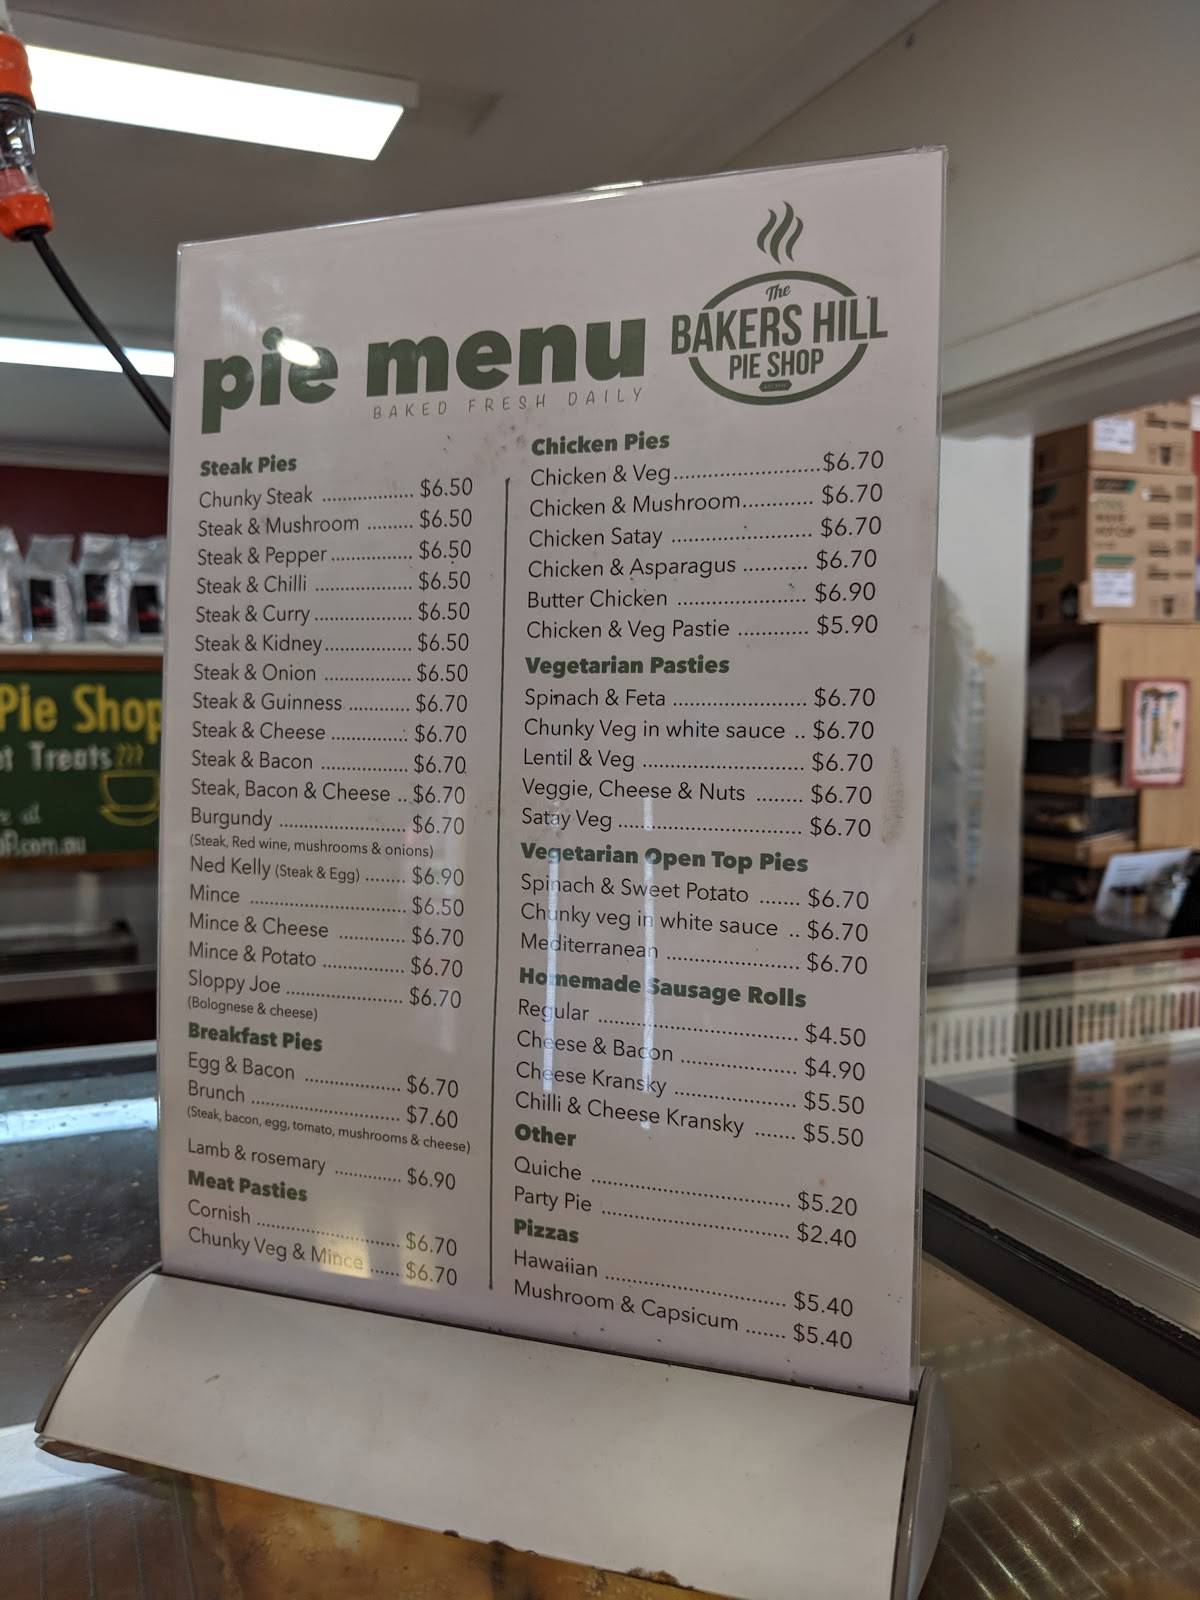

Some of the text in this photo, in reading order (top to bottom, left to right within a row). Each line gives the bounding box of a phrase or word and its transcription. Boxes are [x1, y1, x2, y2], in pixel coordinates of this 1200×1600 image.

[766, 283, 791, 302] The
[671, 296, 888, 355] BAKERS HILL
[201, 318, 646, 434] pie menu
[729, 348, 824, 380] PIE SHOP
[373, 387, 644, 420] BAKED FRESH DAILY
[531, 430, 670, 456] Chicken Pies
[200, 454, 297, 477] Steak Pies
[530, 450, 884, 487] Chicken & Veg $6.70
[199, 477, 472, 511] Chunky Steak $6.50
[198, 508, 472, 538] Steak & Mushroom $6.50
[529, 516, 881, 549] Chicken Satay $6.70
[196, 571, 470, 595] Steak & Chilli $6.50
[528, 582, 876, 609] Butter Chicken $6.90
[526, 614, 878, 643] Chicken & Veg Pastie $5.90
[524, 654, 730, 679] Vegetarian Pasties
[0, 683, 162, 744] Pie Shop
[192, 691, 467, 714] Steak & Guinness $6.70
[524, 686, 875, 711] Spinach & Feta $6.70
[524, 717, 874, 742] Chunky Veg in white sauce $6.70
[28, 741, 113, 771] Treats
[192, 749, 466, 774] Steak & Bacon $6.70
[191, 778, 465, 804] Steak, Bacon & Cheese $6.70
[522, 777, 872, 804] Veggie, Cheese & Nuts $6.70
[191, 806, 464, 834] Burgundy $6.70
[190, 833, 434, 859] (Steak, Red wine, mushrooms & onions)
[520, 842, 808, 875] Vegetarian Open Top Pies
[190, 855, 464, 886] Ned Kelly (Steak & Egg) $6.90
[190, 883, 464, 916] Mince $6.50
[190, 912, 463, 947] Mince & Cheese $6.70
[188, 969, 461, 1008] Sloppy Joe $6.70
[519, 966, 807, 1008] Homemade Sausage Rolls
[188, 996, 318, 1022] (Bolognese & cheese)
[188, 1021, 323, 1052] Breakfast Pies
[188, 1051, 458, 1098] Egg & Bacon $6.70
[188, 1079, 458, 1128] Brunch $7.60
[515, 1090, 863, 1147] Chilli & Cheese Kransky $5.50
[187, 1105, 471, 1155] (Steak, bacon, egg, tomato, mushrooms & cheese)
[514, 1123, 577, 1147] Other
[188, 1138, 455, 1190] Lamb & rosemary $6.90
[188, 1169, 308, 1202] Meat Pasties
[514, 1156, 857, 1216] Quiche $5.20
[187, 1198, 457, 1256] Cornish $6.70
[514, 1185, 856, 1248] Party Pie $2.40
[514, 1218, 579, 1244] Pizzas
[514, 1248, 853, 1317] Hawaiian $5.40
[514, 1278, 852, 1349] Mushroom & Capsicum $5.40
